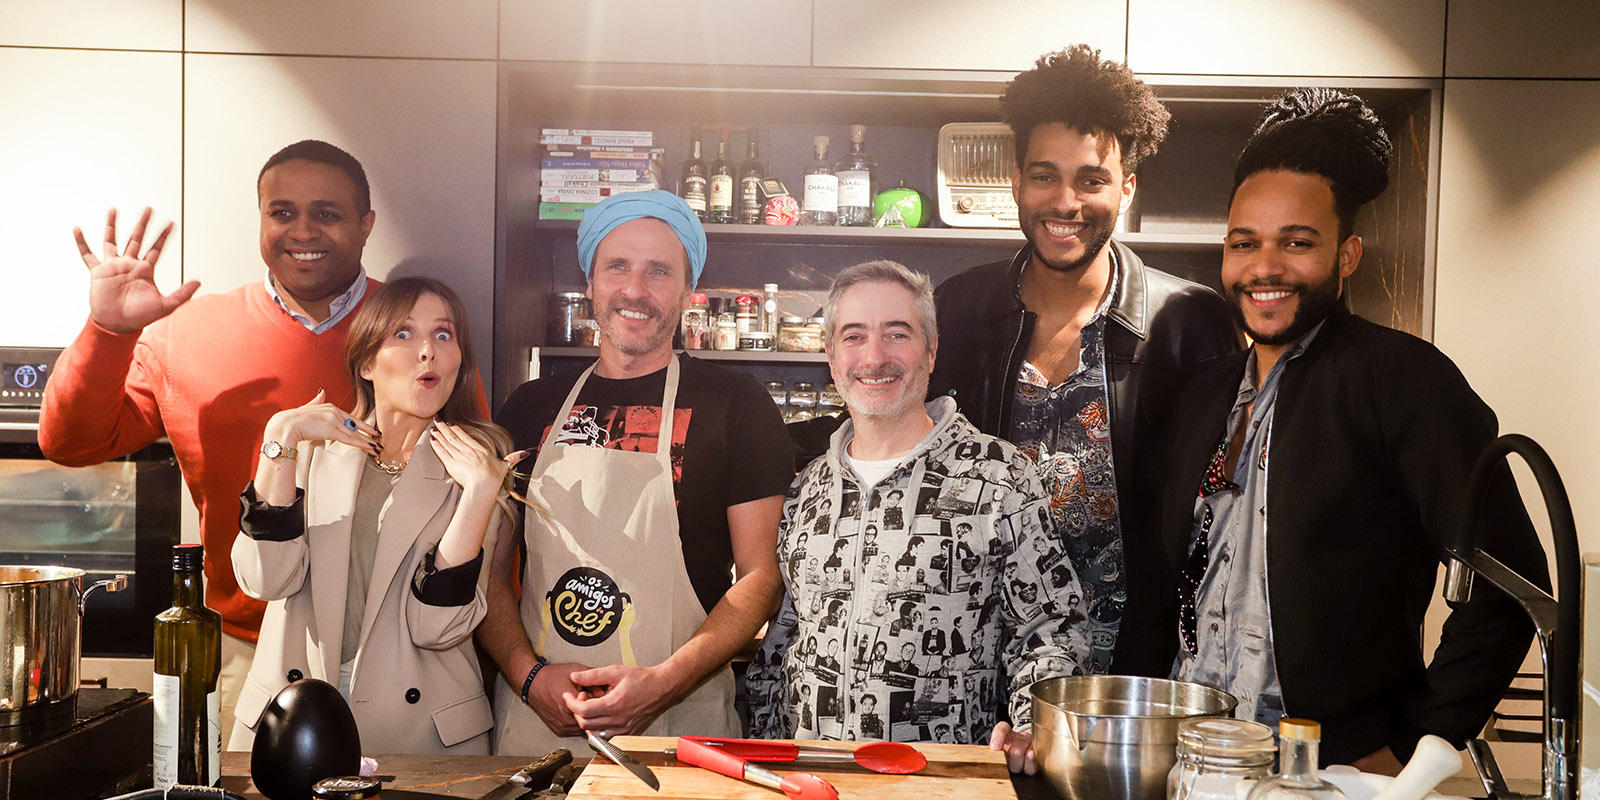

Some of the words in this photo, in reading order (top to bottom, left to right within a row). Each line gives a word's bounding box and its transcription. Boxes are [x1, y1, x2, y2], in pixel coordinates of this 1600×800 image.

[617, 136, 635, 144] DIVINA
[564, 180, 589, 188] Chakall
[588, 577, 602, 587] os
[565, 578, 616, 611] amigos
[554, 590, 616, 637] Chef
